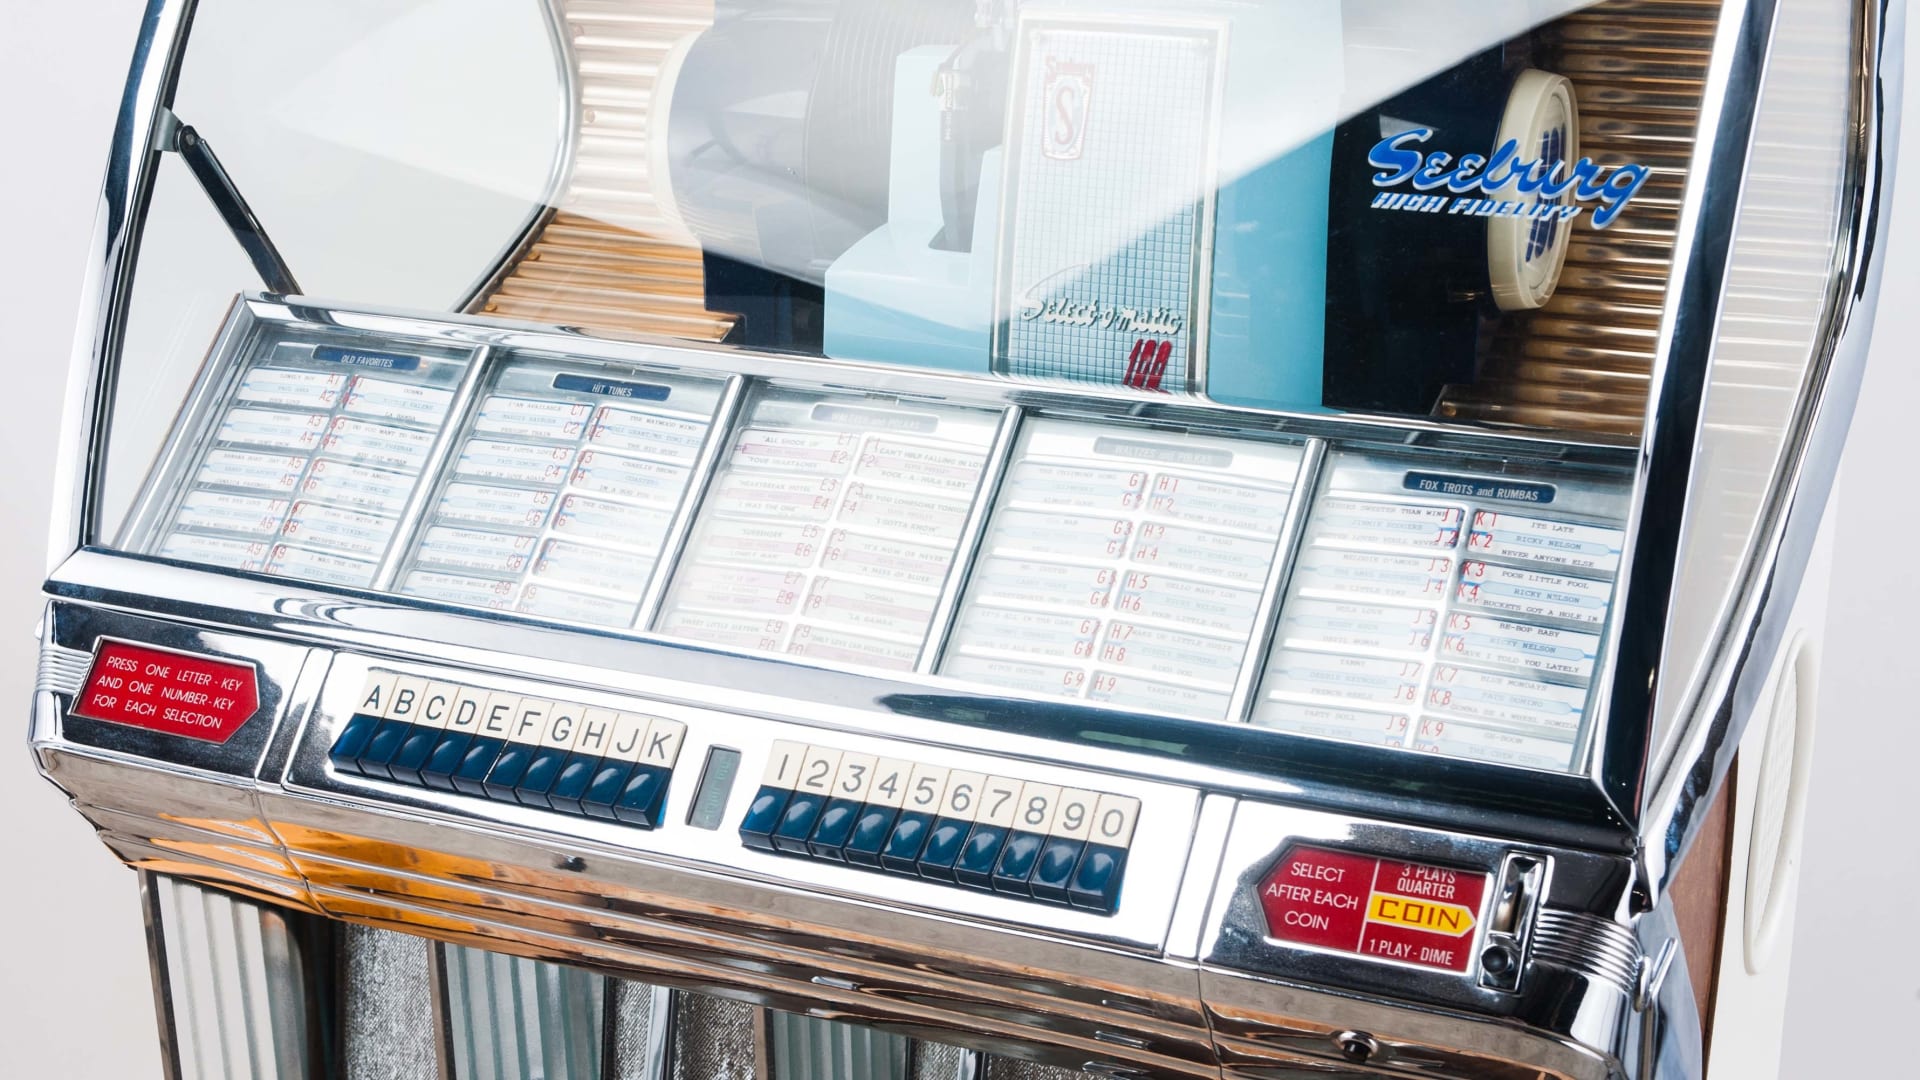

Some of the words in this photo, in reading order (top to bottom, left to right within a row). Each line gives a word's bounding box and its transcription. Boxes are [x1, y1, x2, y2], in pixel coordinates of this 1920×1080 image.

[1368, 128, 1652, 230] Seeburg
[1371, 192, 1449, 213] HIGH
[1448, 197, 1584, 222] FIDELITY
[341, 355, 353, 364] OLD
[356, 356, 393, 367] FAVORITES
[592, 384, 603, 393] HIT
[608, 385, 632, 397] TUNES
[1420, 480, 1438, 490] FOX
[1443, 482, 1473, 495] TROTS
[1477, 488, 1493, 496] and
[1497, 488, 1538, 501] RUMBAS
[1531, 522, 1547, 530] ITS
[1552, 525, 1575, 533] LATE
[1516, 536, 1544, 545] RICKY
[1549, 540, 1581, 550] NELSON
[1502, 550, 1528, 558] NEVER
[1534, 555, 1566, 563] ANYONE
[1502, 571, 1523, 579] POOR
[1529, 575, 1562, 585] LITTLE
[1567, 581, 1589, 589] FOOL
[1514, 588, 1541, 598] RICKY
[1547, 593, 1580, 603] NELSON
[1523, 642, 1557, 653] NELSON
[107, 656, 138, 672] PRESS
[145, 664, 171, 678] ONE
[1525, 660, 1541, 668] YOU
[1546, 663, 1580, 673] LATELY
[97, 676, 122, 688] AND
[128, 681, 154, 694] ONE
[93, 694, 117, 708] FOR
[125, 700, 157, 716] EACH
[163, 708, 222, 729] SELECTION
[364, 685, 380, 710] A
[393, 689, 416, 714] B
[426, 696, 446, 720] C
[455, 701, 476, 725] D
[487, 706, 510, 731] E
[518, 711, 541, 736] F
[552, 717, 572, 741] G
[582, 722, 605, 748] H
[617, 729, 639, 752] J
[649, 732, 672, 759] K
[806, 760, 829, 788] 2
[842, 765, 866, 792] 3
[878, 772, 898, 799] 4
[914, 777, 937, 804] 5
[951, 784, 973, 811] 6
[991, 789, 1011, 817] 7
[1025, 797, 1047, 824] 8
[1064, 803, 1085, 830] 9
[1291, 862, 1345, 882] SELECT
[1402, 864, 1411, 877] 3
[1415, 866, 1456, 883] PLAYS
[1266, 882, 1310, 902] AFTER
[1314, 890, 1358, 910] EACH
[1397, 878, 1456, 899] QUARTER
[1284, 911, 1329, 930] COIN
[1378, 900, 1460, 929] COIN
[1370, 940, 1375, 952] 1
[1379, 941, 1413, 958] PLAY
[1420, 948, 1453, 965] DIME
